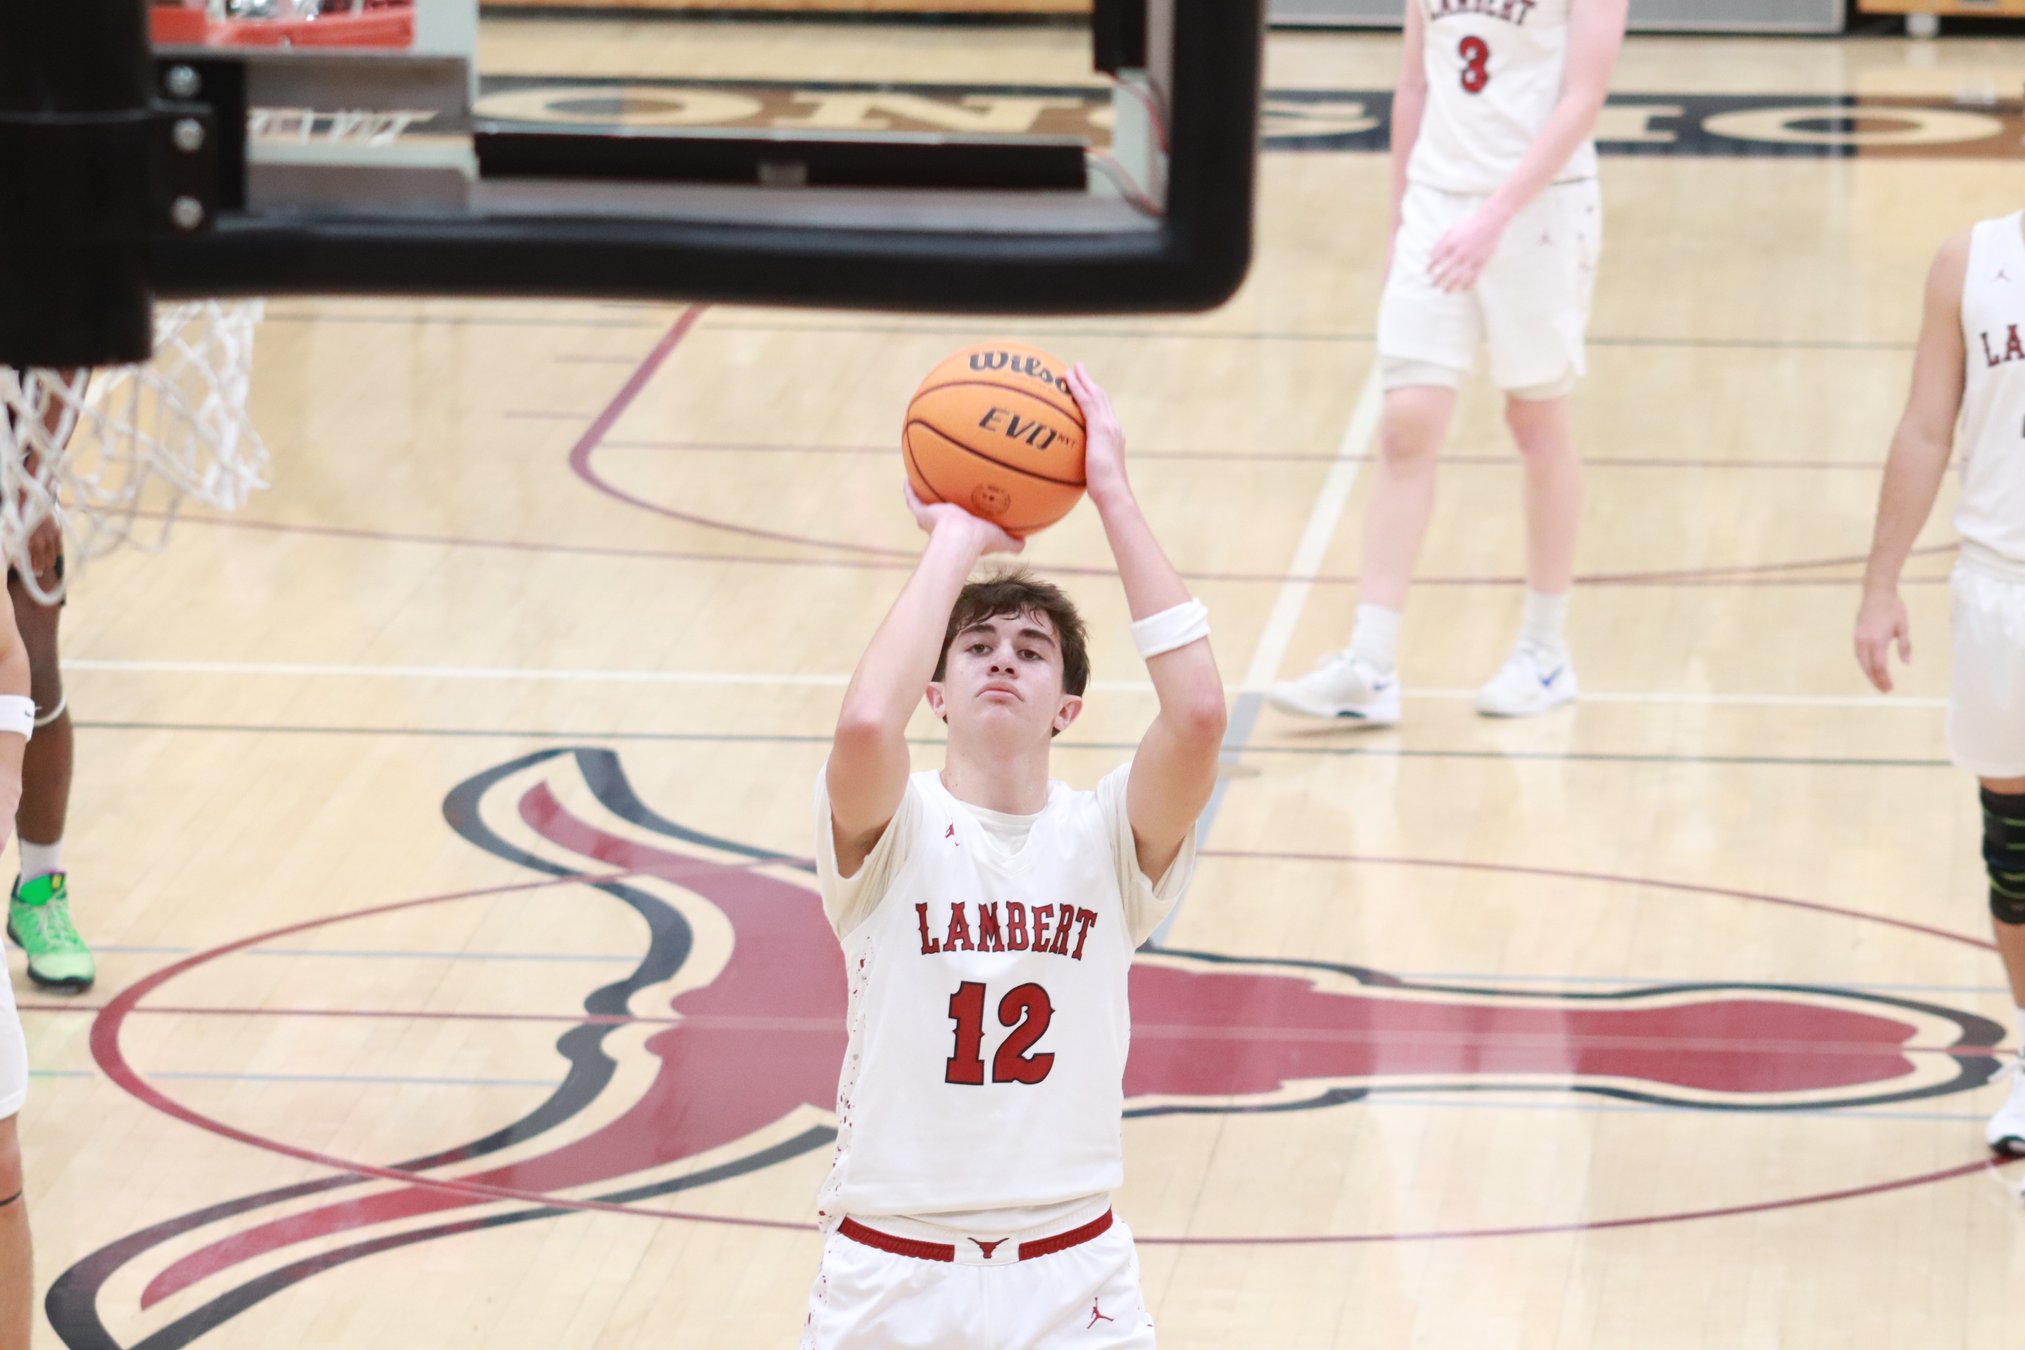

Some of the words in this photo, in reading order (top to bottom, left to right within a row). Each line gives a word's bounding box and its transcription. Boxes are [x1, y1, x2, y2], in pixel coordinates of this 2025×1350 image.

[1458, 35, 1490, 94] 3
[969, 351, 1073, 396] Wilso
[915, 900, 1098, 961] LAMBERT
[944, 980, 1056, 1086] 12
